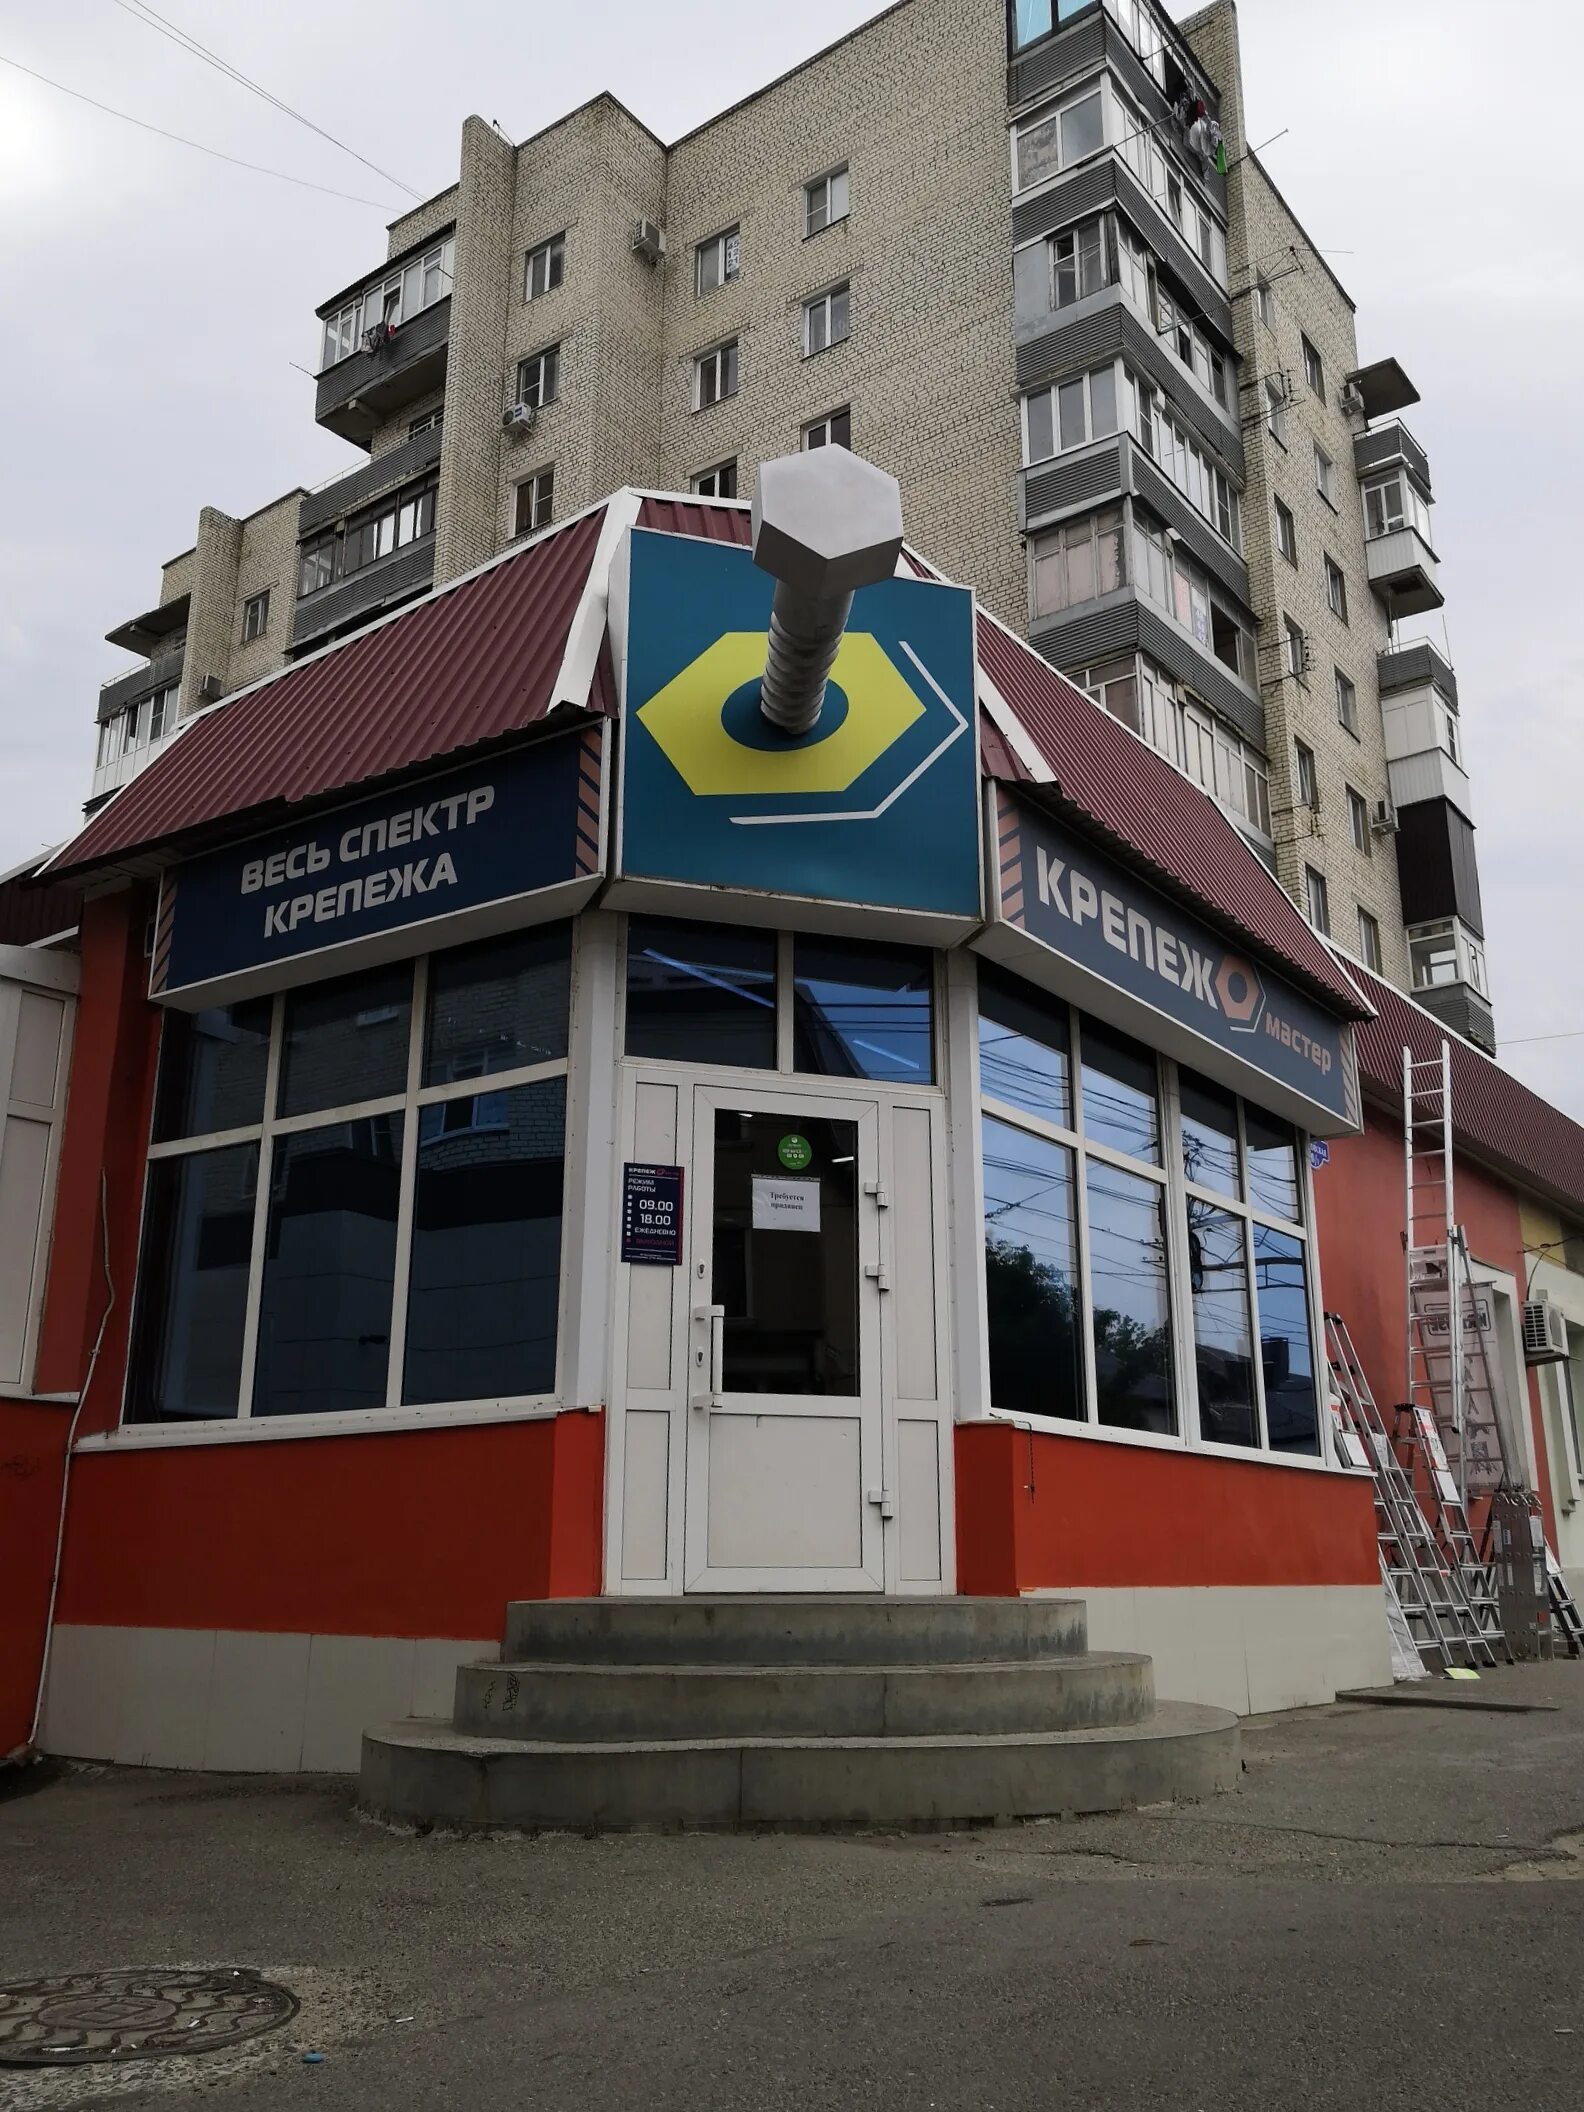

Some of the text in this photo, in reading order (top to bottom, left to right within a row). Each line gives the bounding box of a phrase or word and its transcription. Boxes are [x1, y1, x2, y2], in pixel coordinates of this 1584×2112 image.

[240, 785, 495, 895] ВЕСЬ СПЕКТР
[263, 852, 459, 939] КРЕПЕЖА
[628, 1177, 655, 1186] РЕЖИМ
[627, 1185, 656, 1193] РАБОТЫ
[769, 1191, 805, 1202] Требуется
[639, 1199, 674, 1212] 09.00
[640, 1213, 672, 1226] 18.00
[634, 1226, 677, 1236] ЕЖЕДНЕВНО
